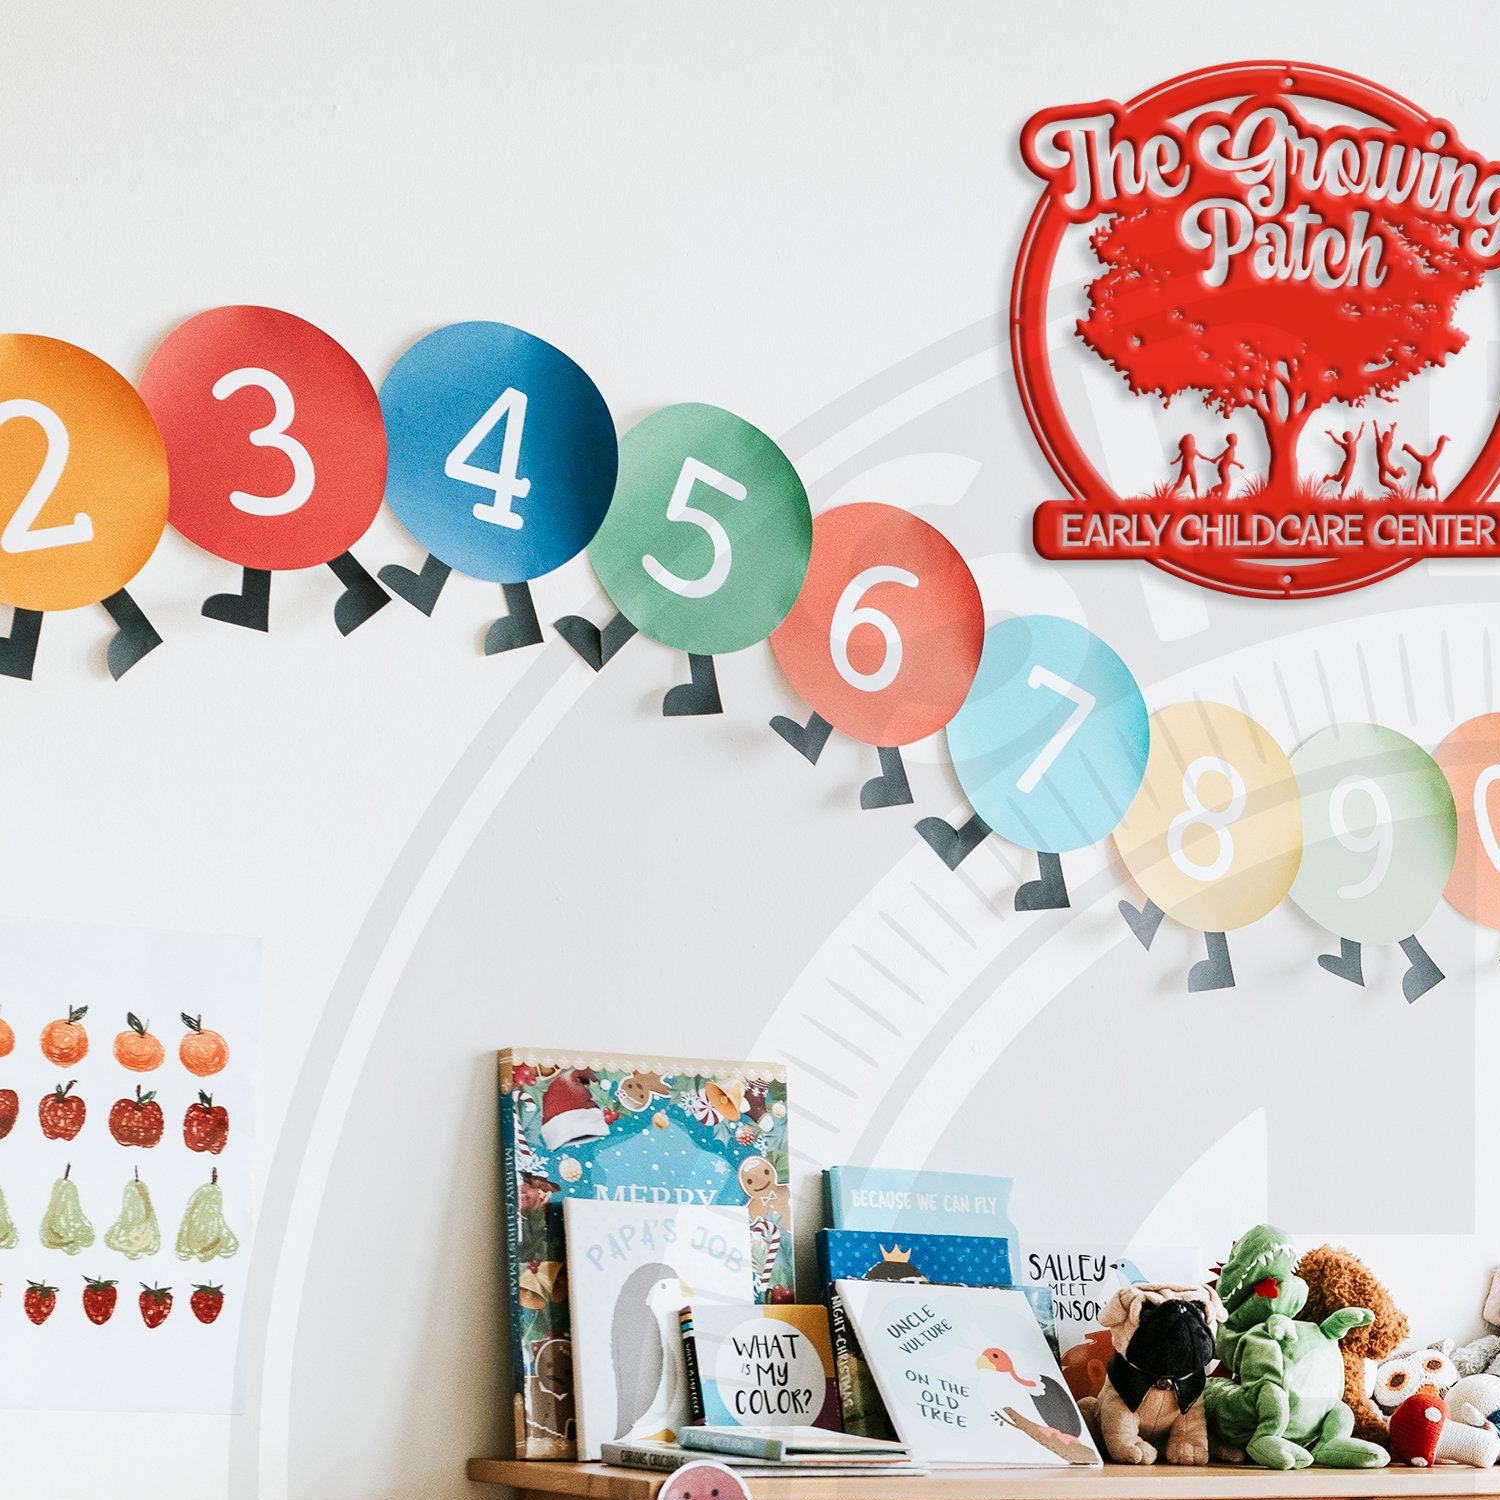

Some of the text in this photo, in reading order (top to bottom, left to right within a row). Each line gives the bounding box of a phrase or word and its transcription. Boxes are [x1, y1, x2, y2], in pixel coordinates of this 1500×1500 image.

[1034, 114, 1190, 210] The
[1181, 198, 1387, 289] Patch
[1061, 513, 1498, 548] EARLY CHILDCARE CENTER
[0, 398, 94, 554] 2
[211, 367, 316, 517] 3
[444, 387, 532, 531] 4
[641, 456, 748, 599] 5
[828, 564, 920, 692] 6
[1015, 665, 1096, 794] 7
[1167, 755, 1247, 881] 8
[1328, 774, 1393, 899] 9
[850, 1190, 997, 1215] BECAUSE WE CAN FLY
[586, 1218, 743, 1273] PAPA'S JOB
[1029, 1253, 1106, 1282] SALLEY
[1049, 1283, 1087, 1296] MEET
[887, 1304, 935, 1339] UNCLE
[899, 1318, 953, 1354] VULTURE
[732, 1334, 800, 1359] WHAT
[905, 1369, 969, 1397] ON THE
[735, 1388, 813, 1415] COLOR?
[921, 1390, 959, 1410] OLD
[917, 1403, 968, 1428] TREE
